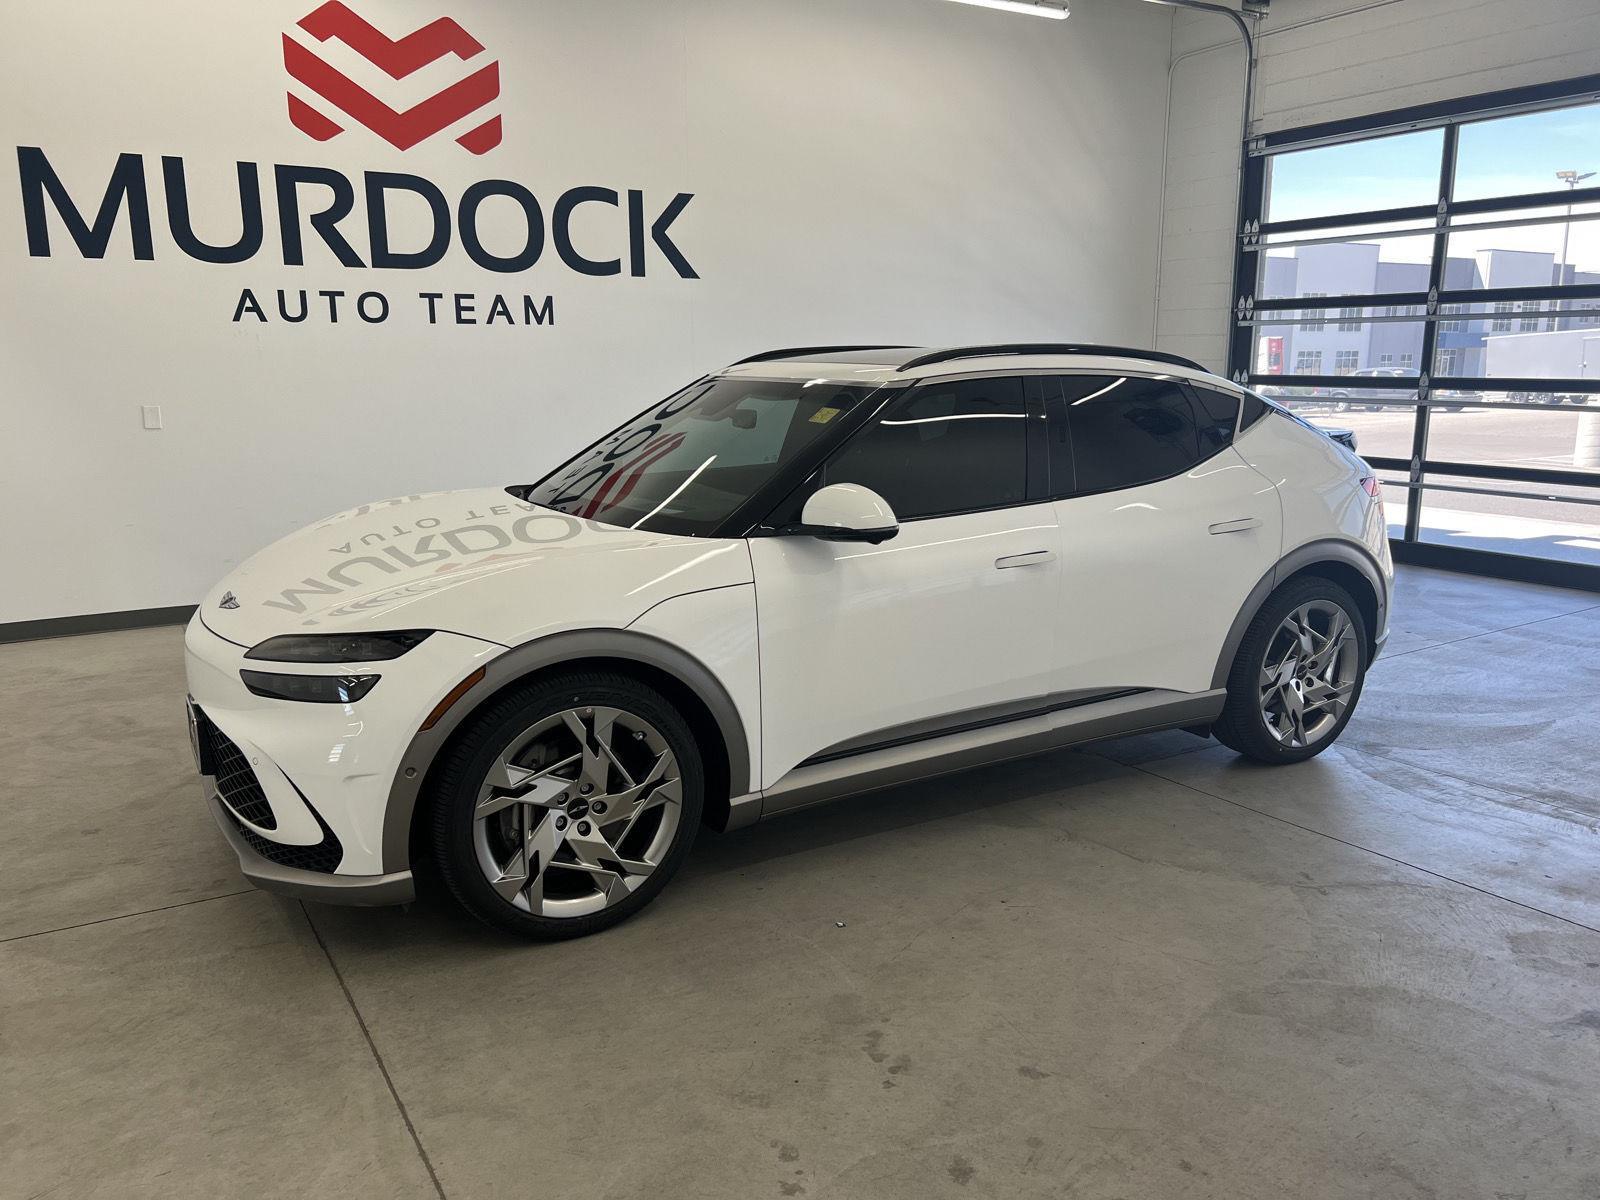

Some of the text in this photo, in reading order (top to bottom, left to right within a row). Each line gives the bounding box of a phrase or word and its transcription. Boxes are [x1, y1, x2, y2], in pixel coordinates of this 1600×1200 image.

[17, 146, 700, 279] MURDOCK
[233, 289, 555, 325] AUTO TEAM
